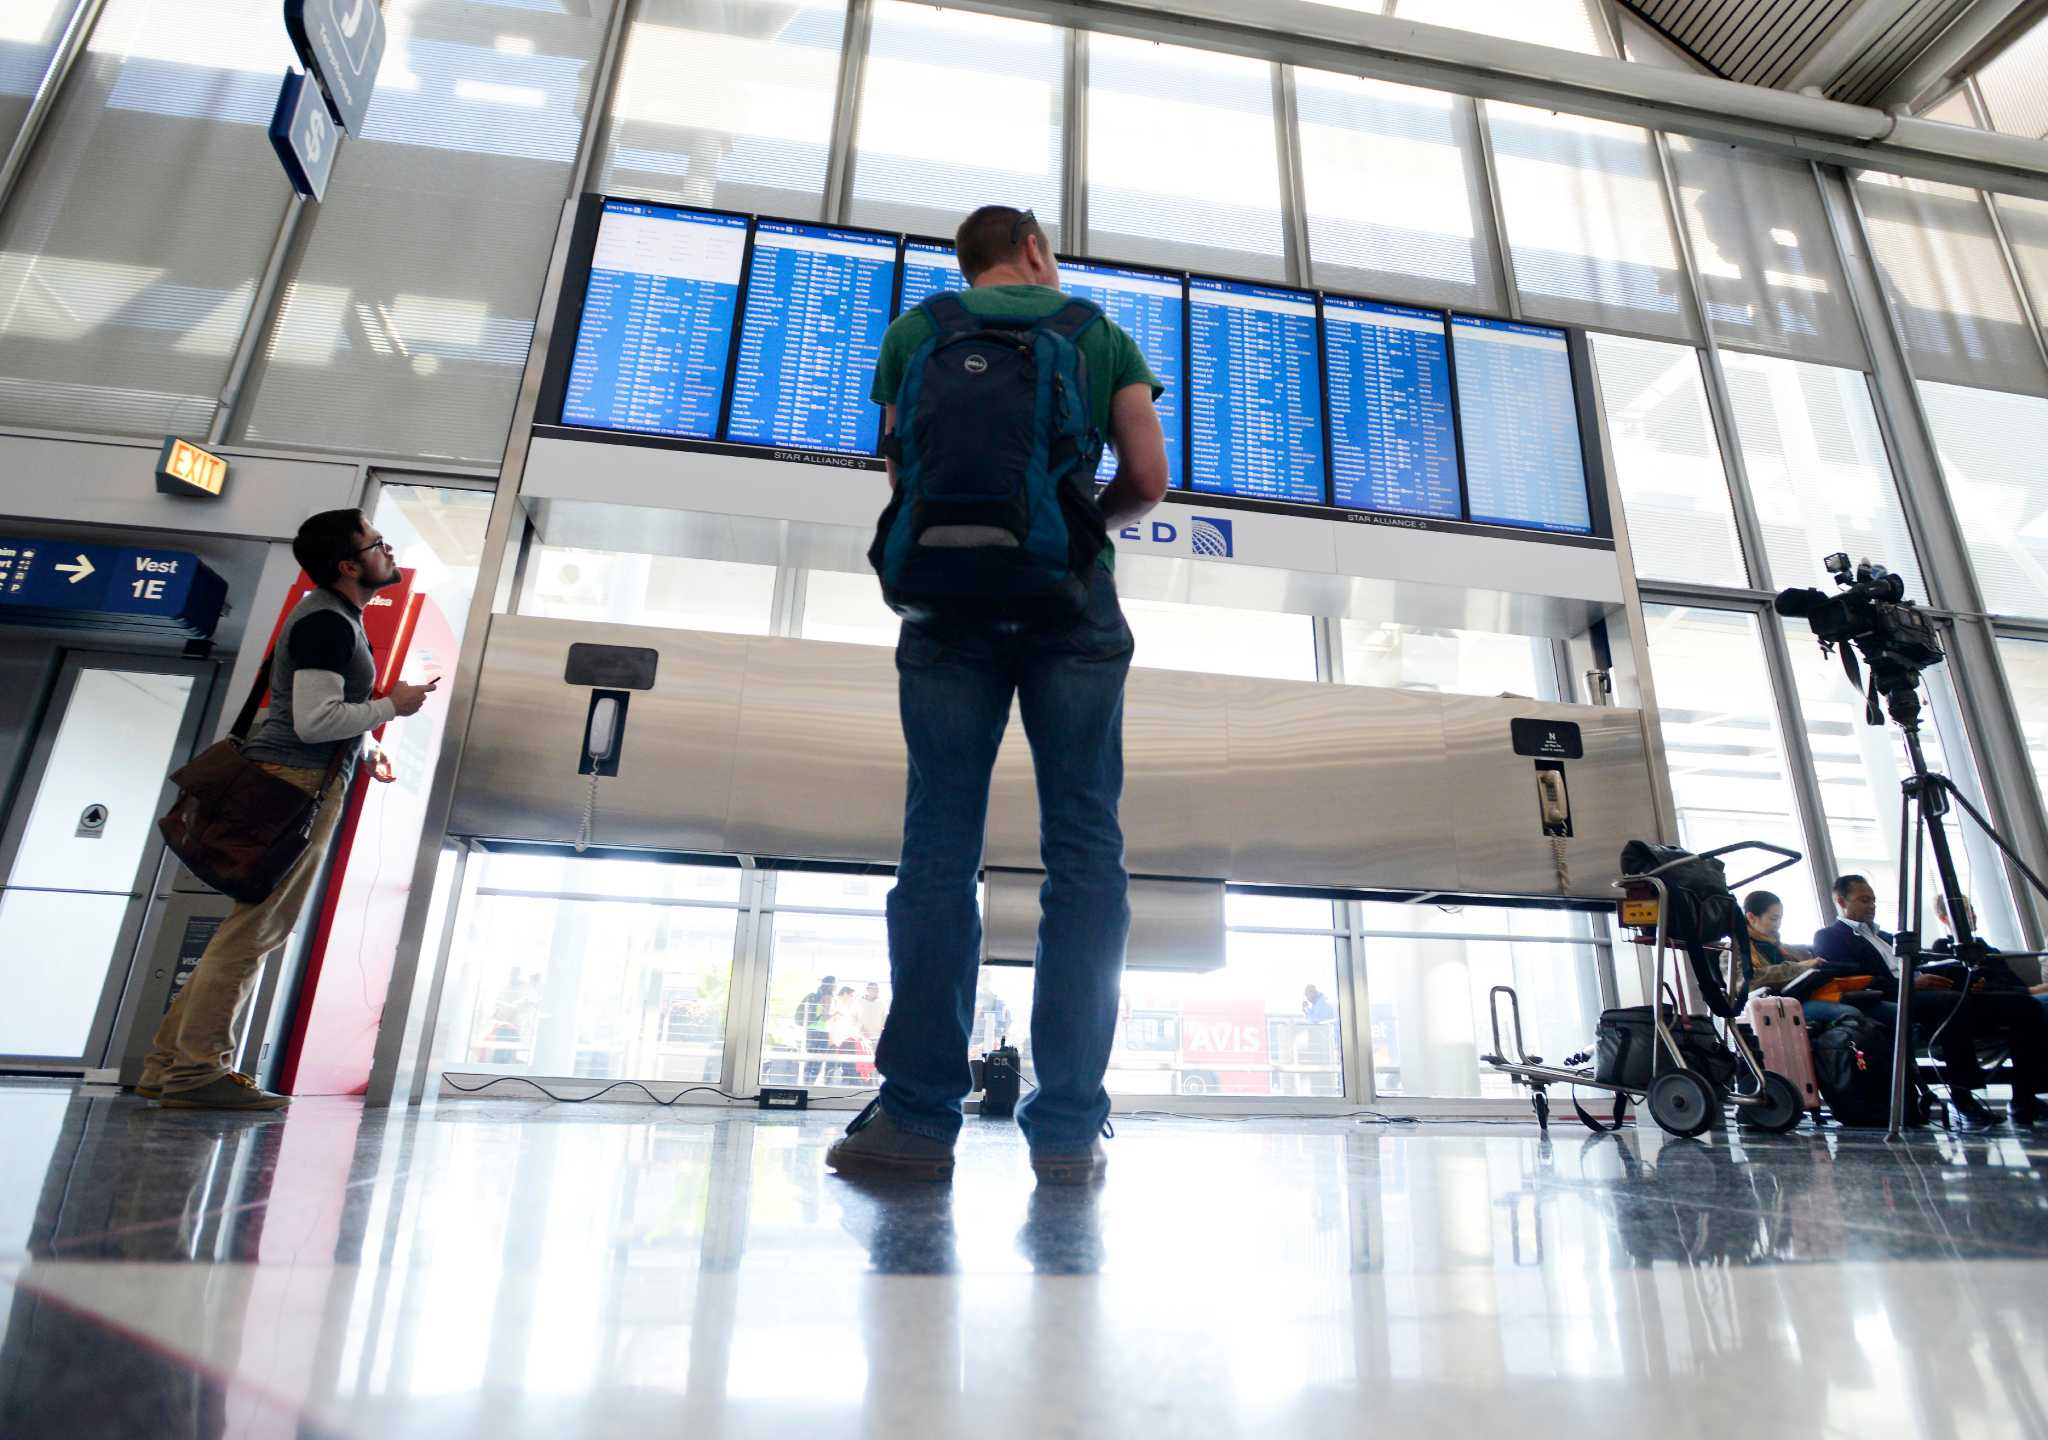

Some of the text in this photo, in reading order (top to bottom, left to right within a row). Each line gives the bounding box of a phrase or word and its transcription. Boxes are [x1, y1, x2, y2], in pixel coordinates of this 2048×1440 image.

[173, 444, 220, 489] EXIT
[774, 451, 855, 467] STAR ALLIANCE
[1347, 514, 1417, 528] STAR ALLIANCE
[135, 556, 179, 574] Vest
[131, 579, 167, 600] 1E
[1190, 1024, 1261, 1052] AVIS
